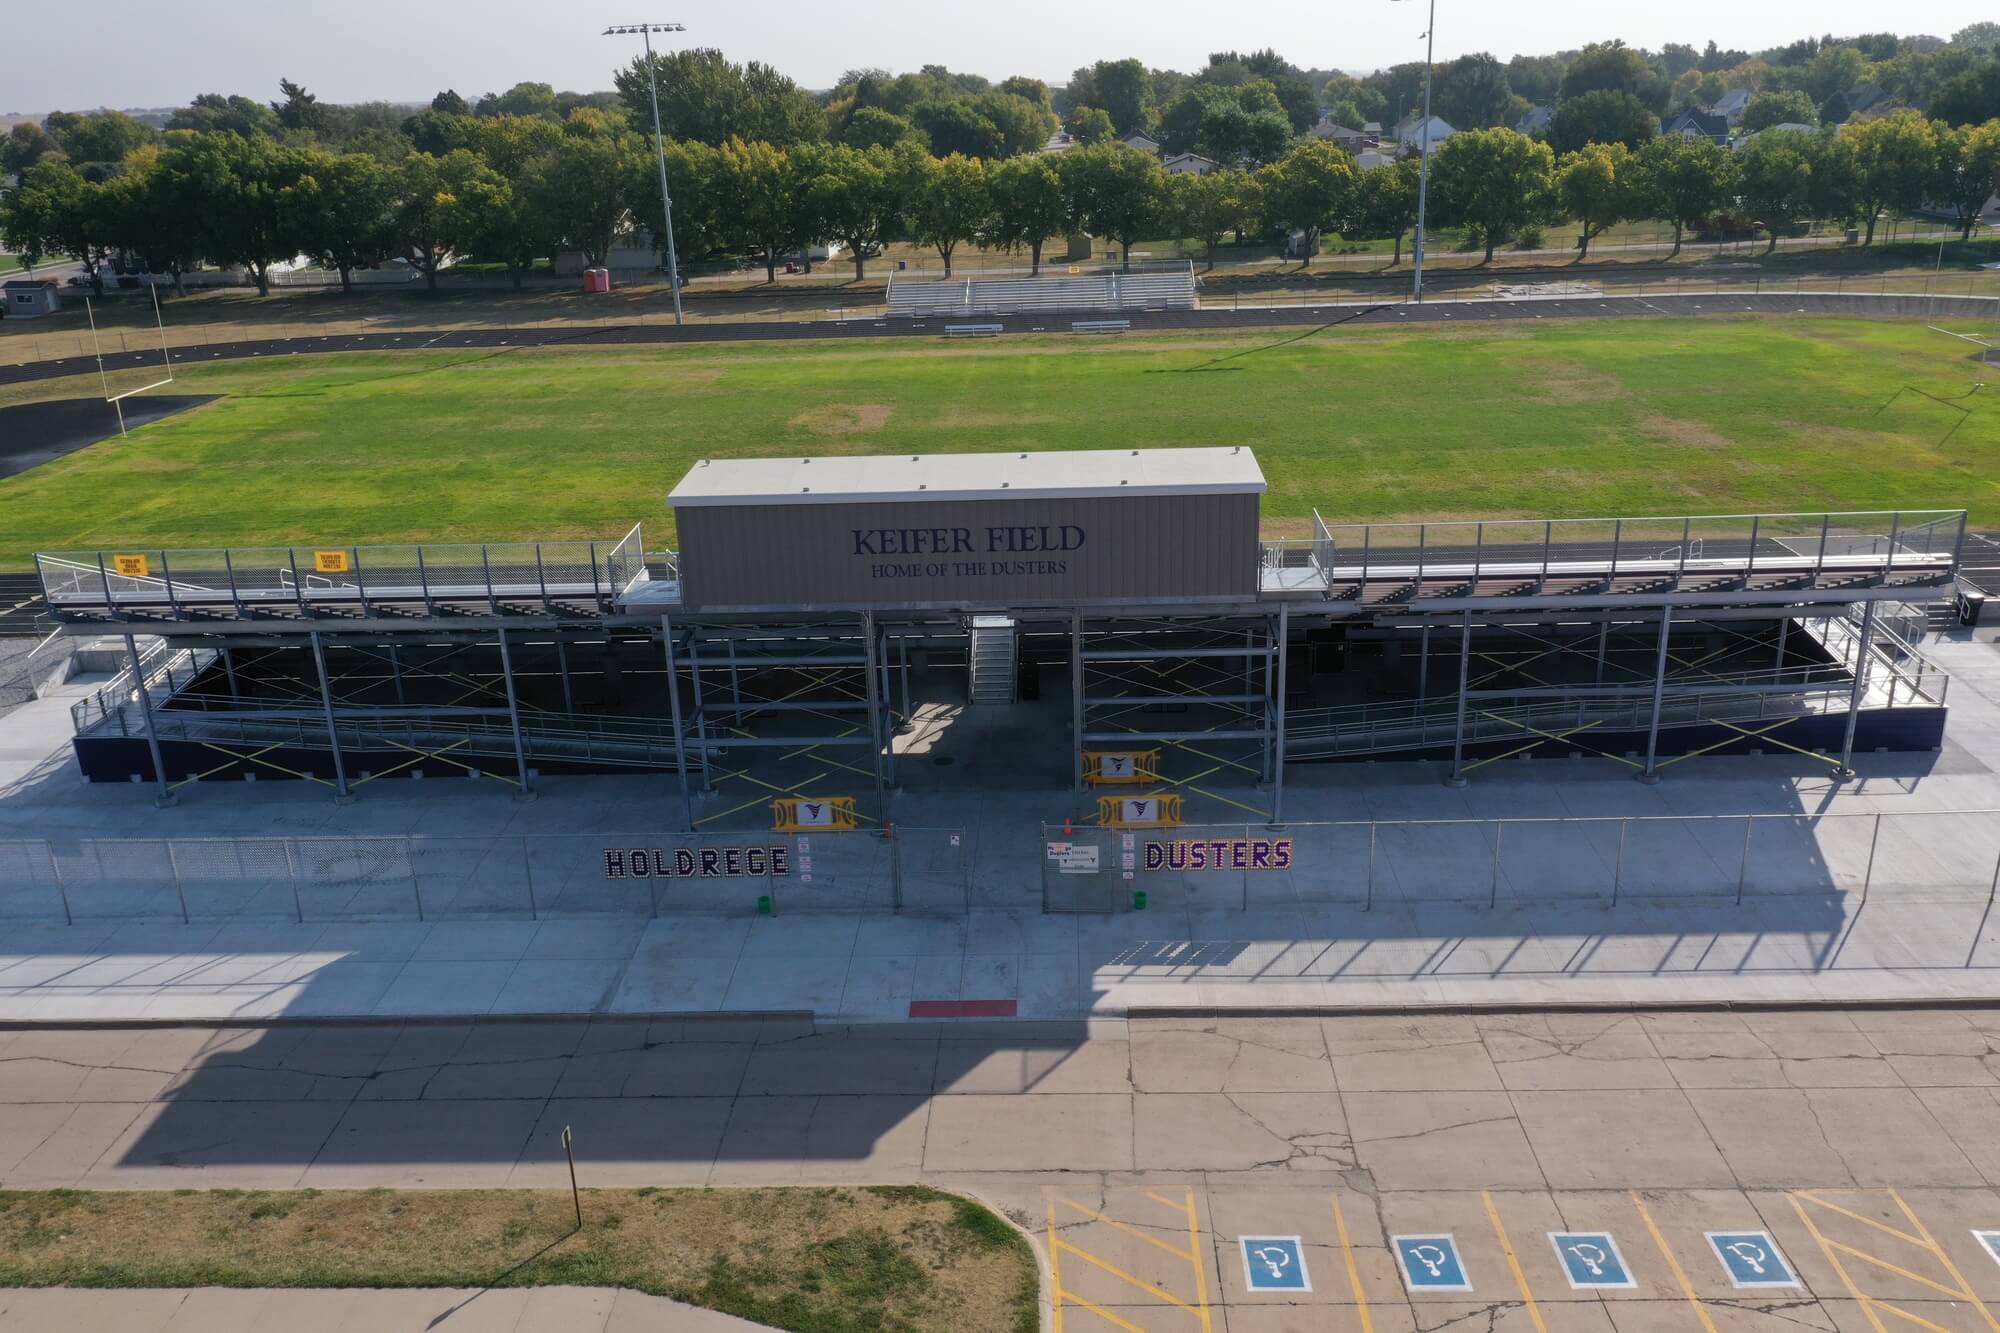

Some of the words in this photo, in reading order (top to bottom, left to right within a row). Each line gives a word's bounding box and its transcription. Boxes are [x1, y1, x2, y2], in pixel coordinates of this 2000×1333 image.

[851, 527, 975, 555] KEIFER
[985, 525, 1086, 553] FIELD
[871, 563, 922, 578] HOME
[926, 562, 948, 577] OF
[952, 561, 986, 576] THE
[991, 560, 1067, 576] DUSTERS
[604, 847, 788, 879] HOLDREGE
[1144, 840, 1291, 870] DUSTERS
